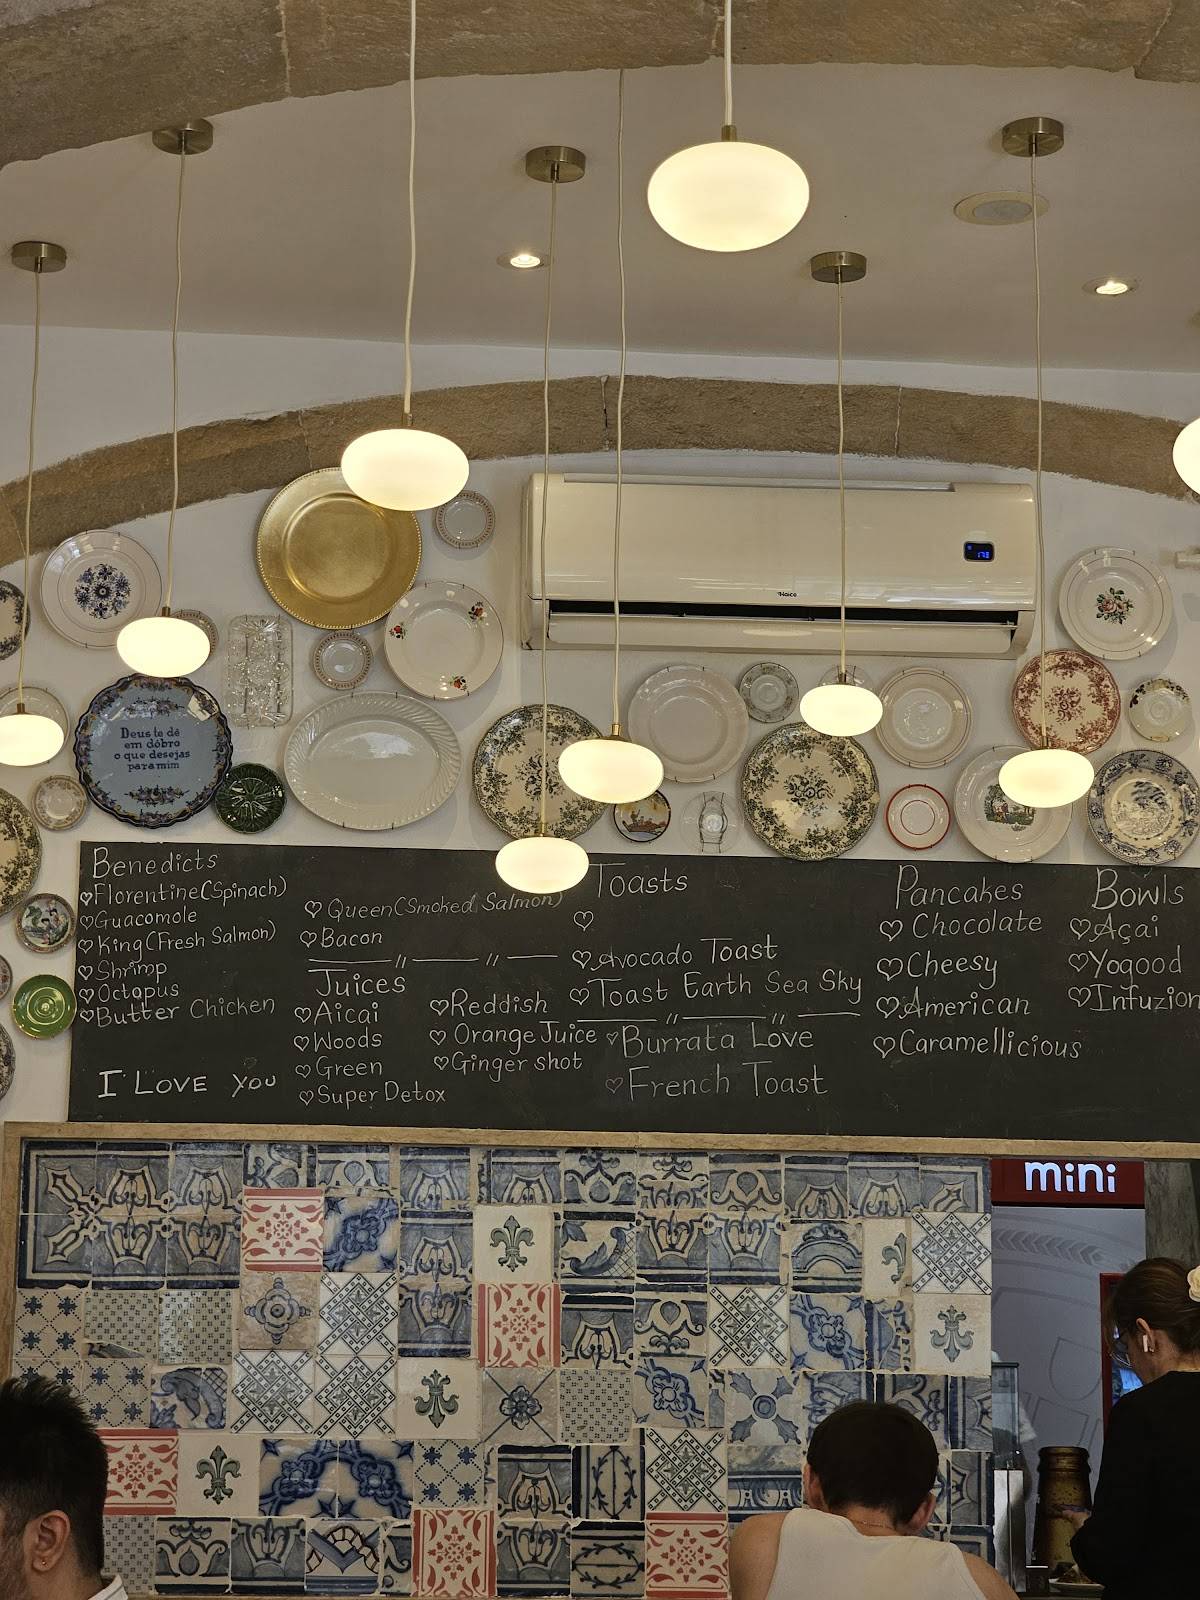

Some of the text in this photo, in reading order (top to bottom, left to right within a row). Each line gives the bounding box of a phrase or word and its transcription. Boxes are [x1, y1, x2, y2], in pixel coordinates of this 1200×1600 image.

[124, 741, 142, 749] em
[124, 752, 145, 762] que
[149, 750, 190, 761] desejas
[92, 846, 219, 879] Benedicts
[589, 862, 689, 898] Toasts
[895, 864, 1024, 910] Pancakes
[1091, 867, 1185, 911] Bowls
[94, 905, 198, 929] Guacomole
[481, 891, 563, 912] Salmon)
[211, 919, 277, 945] Salmon)
[320, 926, 384, 948] Bacon
[912, 909, 1043, 939] Chocolate
[1089, 912, 1159, 945] Açai
[590, 934, 779, 972] Avocado Toast
[95, 960, 168, 984] Shrimp
[308, 968, 407, 997] Juices
[906, 950, 999, 990] Cheesy
[451, 988, 549, 1017] Reddish
[587, 968, 862, 1008] Toast Earth Sea Sky
[898, 986, 1032, 1020] American
[97, 997, 276, 1028] Butter Chicken
[313, 1000, 379, 1026] Aicai
[313, 1026, 383, 1053] Woods
[454, 1020, 598, 1056] Orange Juice
[622, 1021, 815, 1059] Burrata Love
[899, 1026, 1083, 1059] Caramellicious
[316, 1055, 384, 1081] Green
[451, 1051, 584, 1083] Ginger shot
[628, 1060, 829, 1101] French Toast
[98, 1069, 123, 1099] I
[317, 1080, 447, 1110] Super Detox
[1024, 1161, 1116, 1193] mini
